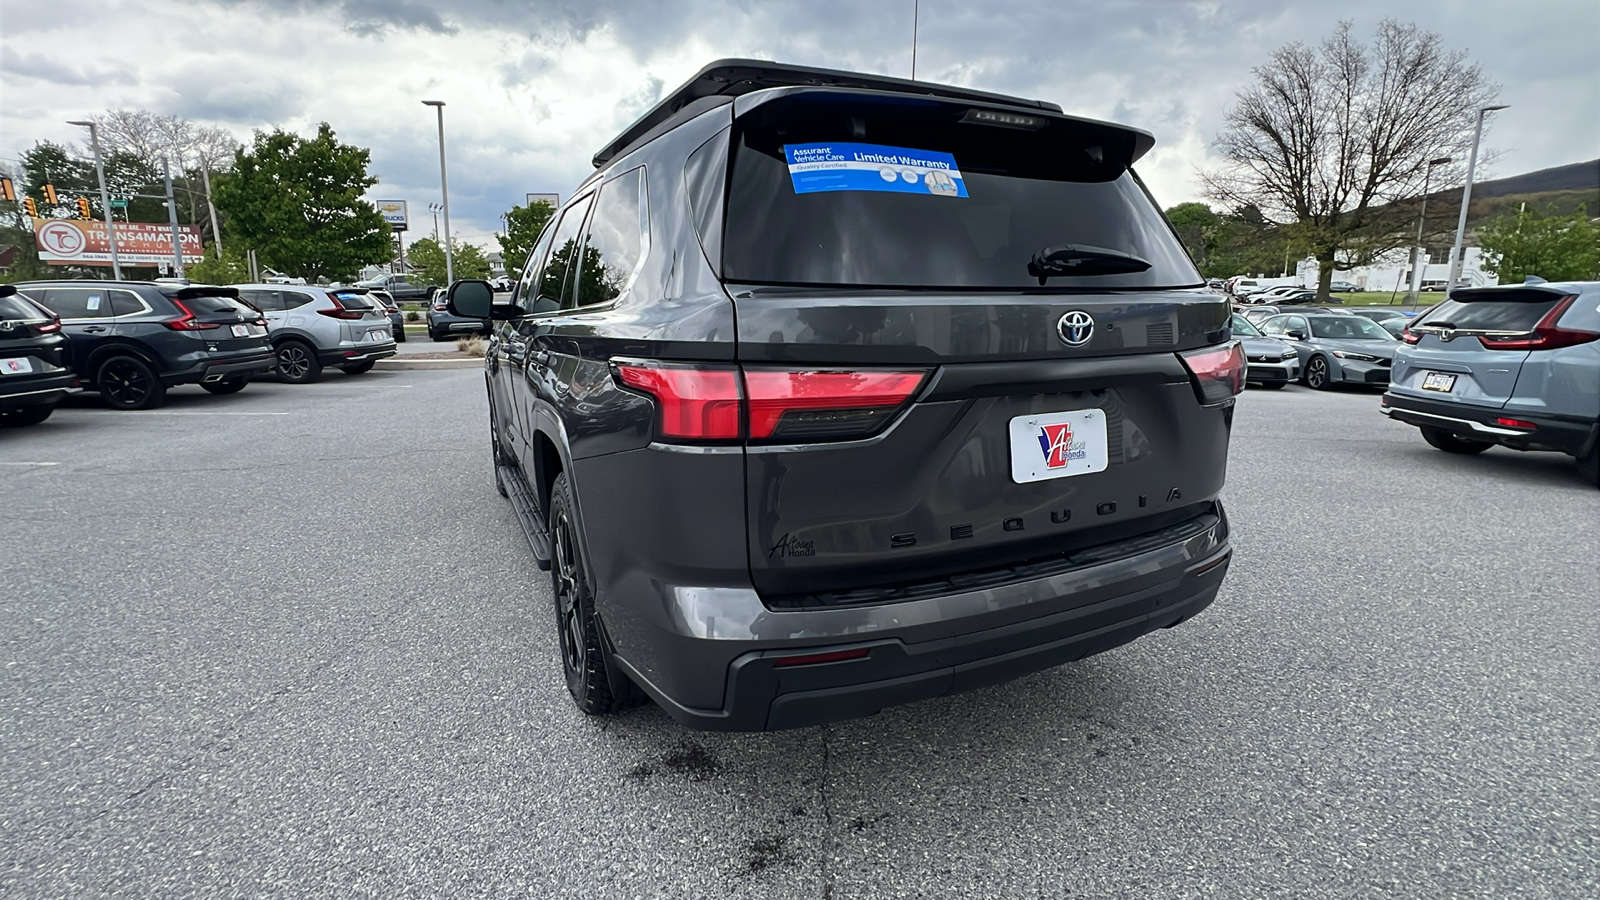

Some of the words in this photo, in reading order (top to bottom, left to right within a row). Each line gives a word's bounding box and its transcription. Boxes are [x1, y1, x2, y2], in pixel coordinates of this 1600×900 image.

[794, 147, 831, 155] Assurant
[794, 154, 825, 163] Vehicle
[825, 153, 845, 161] Care
[853, 152, 898, 164] Limited
[898, 156, 950, 170] Warranty
[87, 230, 199, 244] TRNS4MATON
[889, 487, 1182, 549] SEQUOIA
[787, 548, 816, 558] Honda
